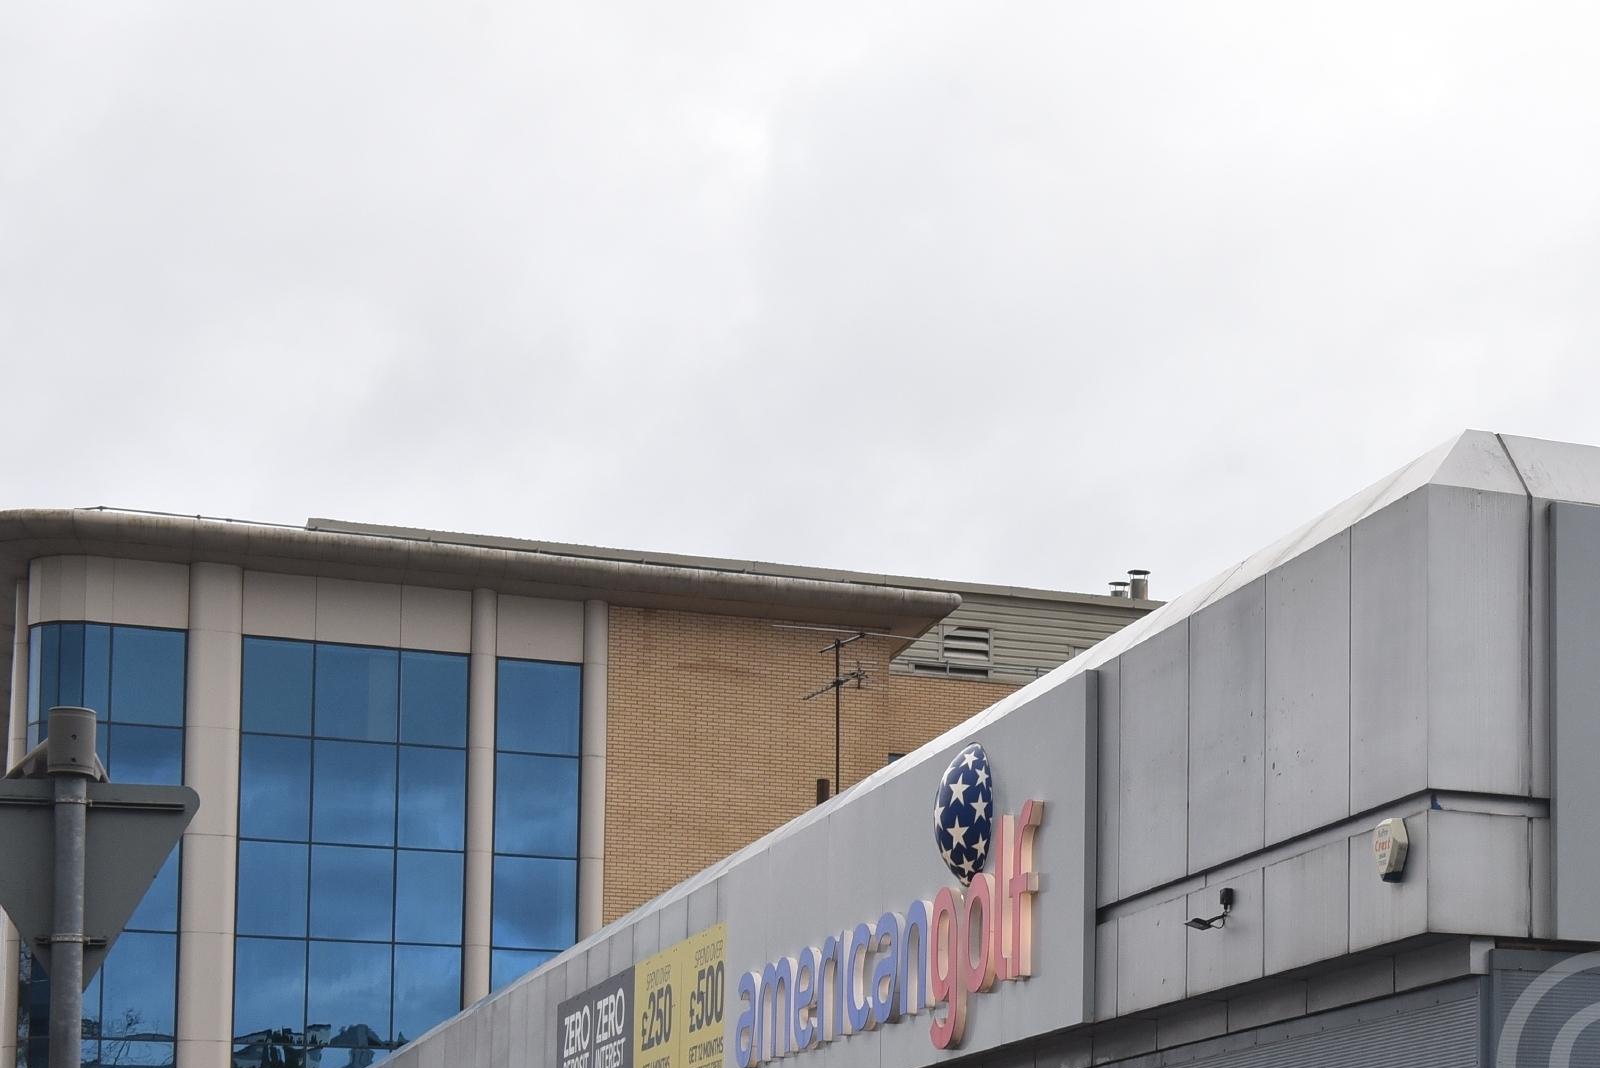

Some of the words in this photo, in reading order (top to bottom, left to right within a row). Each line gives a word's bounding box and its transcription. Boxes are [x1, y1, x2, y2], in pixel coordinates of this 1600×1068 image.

[735, 799, 1044, 1068] americangolf
[596, 987, 625, 1043] ZERO
[641, 983, 672, 1051] £250
[689, 960, 724, 1033] £500
[564, 1005, 590, 1058] ZERO
